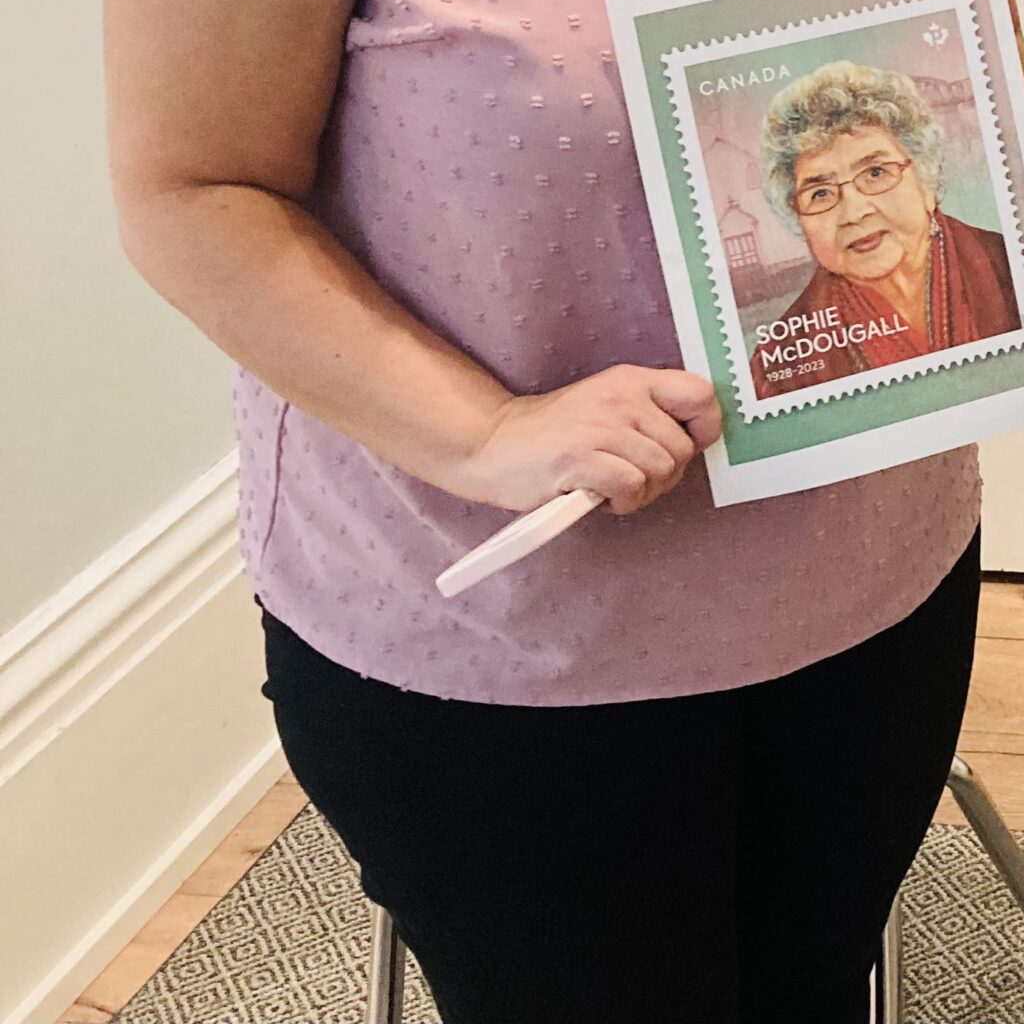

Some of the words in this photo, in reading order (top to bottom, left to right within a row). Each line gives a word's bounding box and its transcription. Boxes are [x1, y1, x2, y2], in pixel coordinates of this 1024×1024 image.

[699, 64, 791, 96] CANADA
[755, 306, 841, 345] SOPHIE
[760, 313, 909, 369] McDOUGALL
[766, 359, 825, 382] 1928-2023
